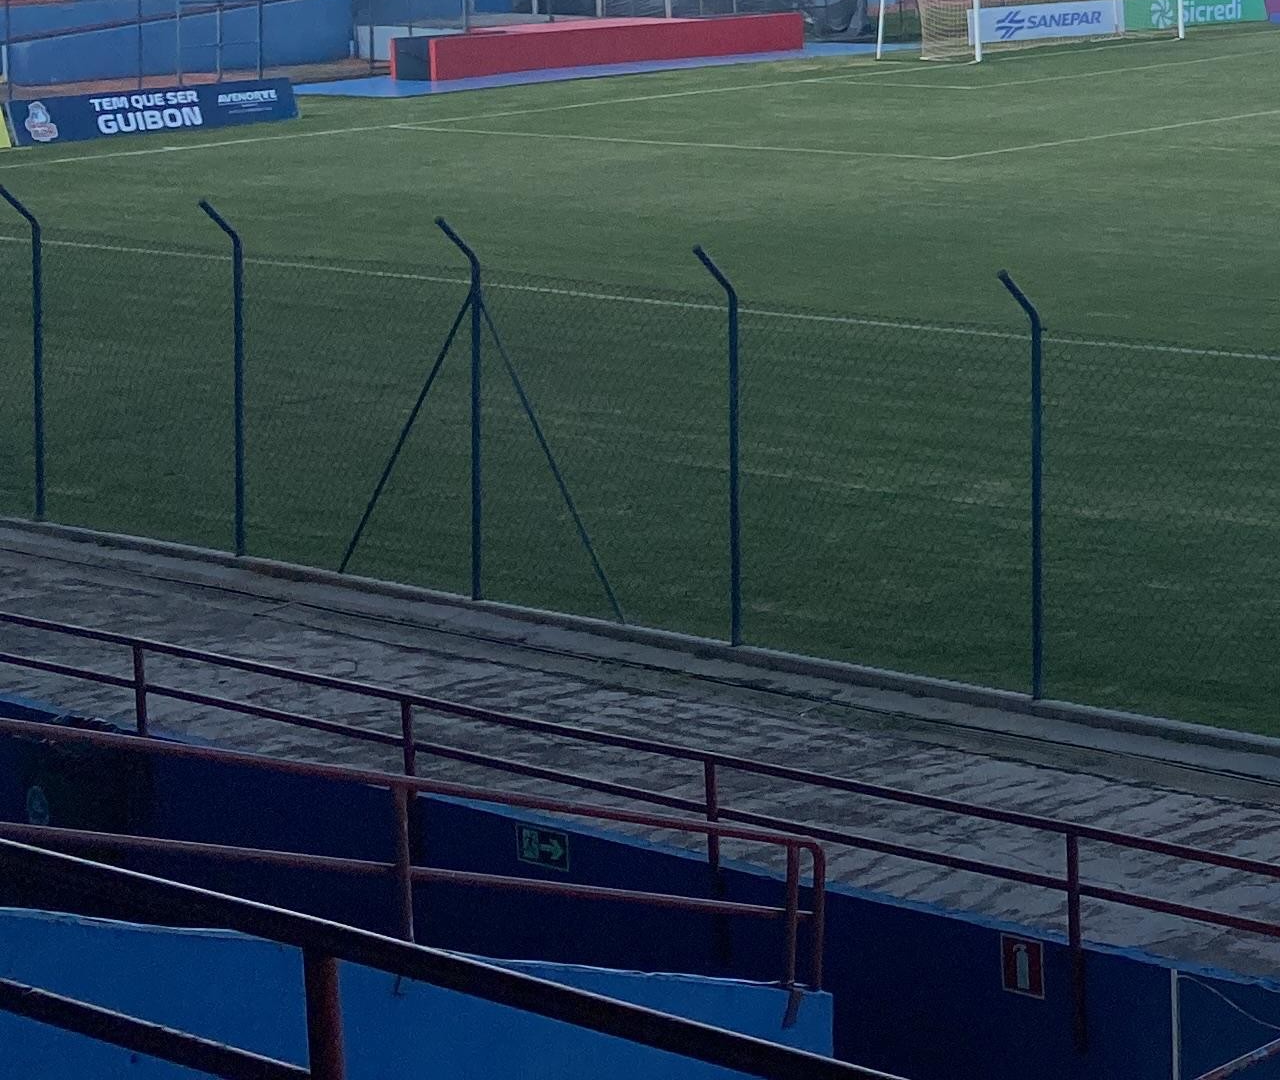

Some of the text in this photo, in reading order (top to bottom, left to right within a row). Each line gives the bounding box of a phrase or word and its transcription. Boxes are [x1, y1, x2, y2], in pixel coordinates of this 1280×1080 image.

[1027, 11, 1102, 29] SANEPAR
[89, 90, 200, 112] TEM QUE SER
[97, 106, 203, 135] GUIBON
